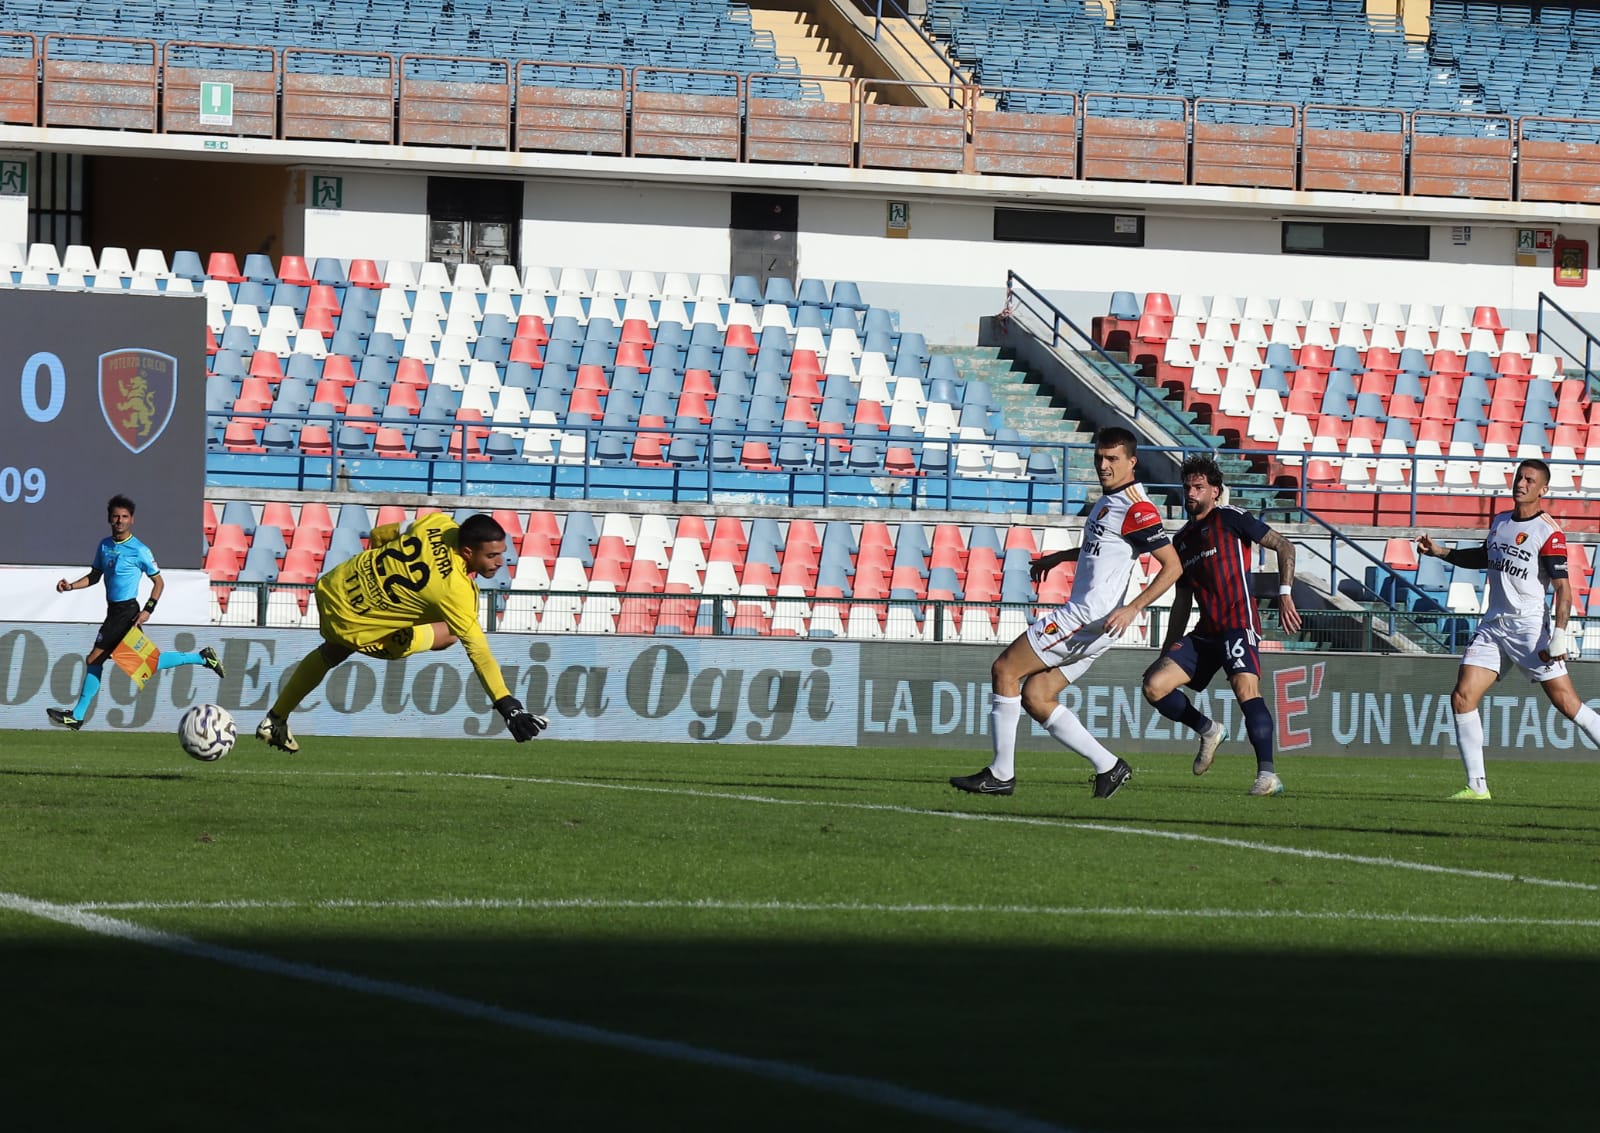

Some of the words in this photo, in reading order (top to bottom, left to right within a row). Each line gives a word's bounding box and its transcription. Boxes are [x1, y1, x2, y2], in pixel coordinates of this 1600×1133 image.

[21, 352, 66, 422] 0
[0, 467, 46, 503] 09
[375, 536, 430, 604] 22
[426, 528, 453, 579] ALASTRA
[0, 629, 197, 728] Oggi
[1224, 637, 1245, 659] 16
[626, 643, 834, 741] Oggi
[864, 680, 917, 733] LA
[1331, 691, 1391, 745] UN
